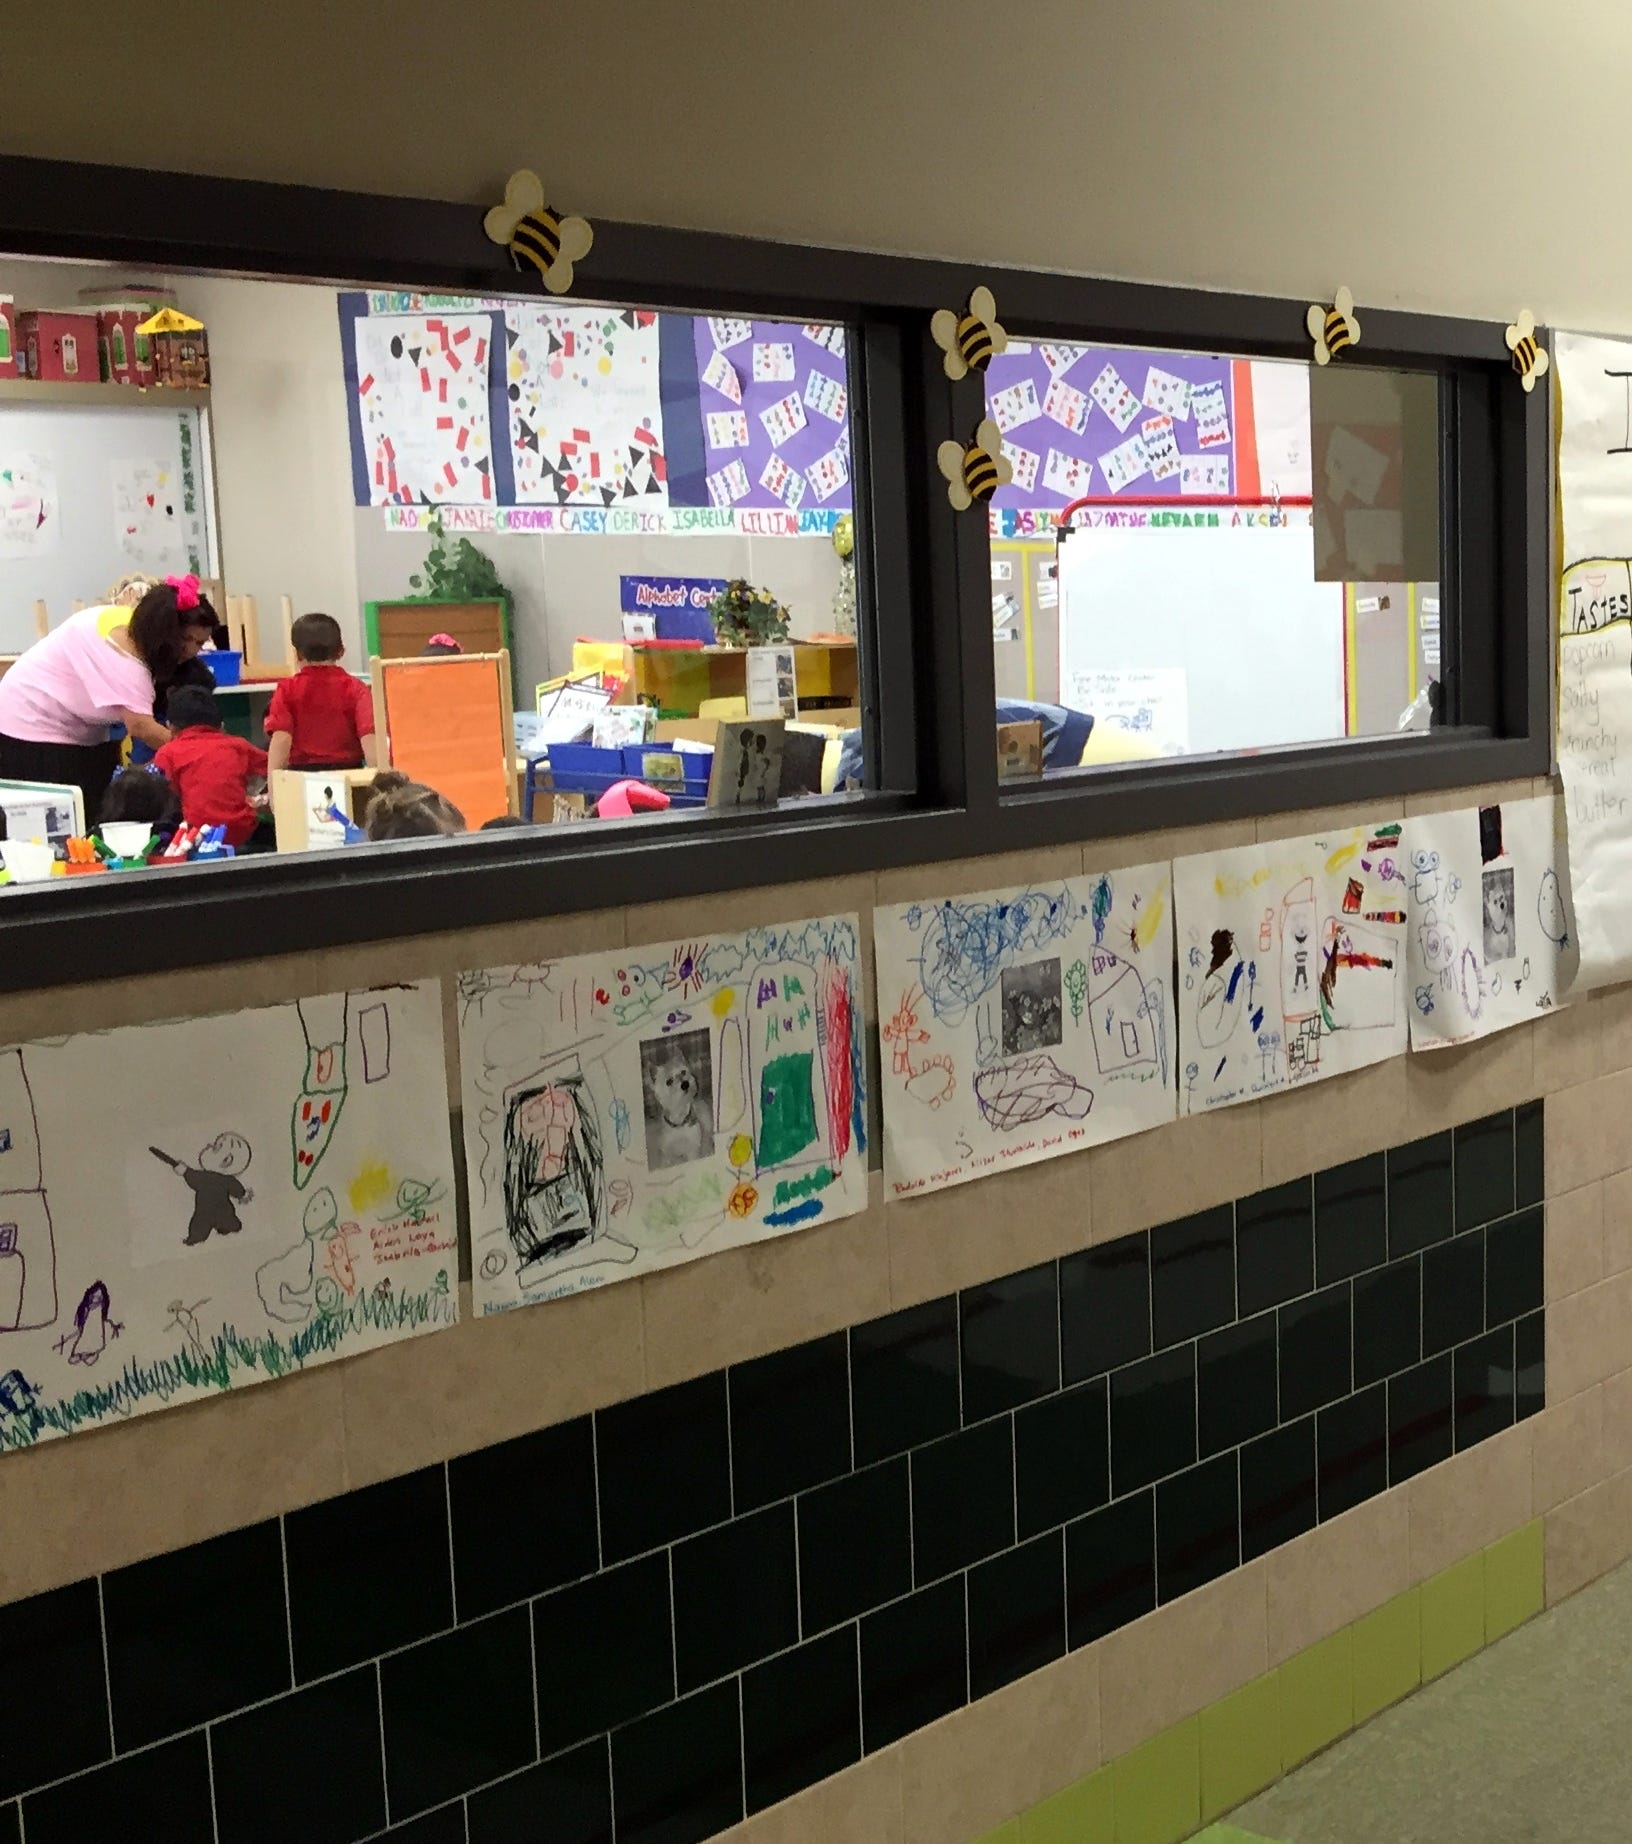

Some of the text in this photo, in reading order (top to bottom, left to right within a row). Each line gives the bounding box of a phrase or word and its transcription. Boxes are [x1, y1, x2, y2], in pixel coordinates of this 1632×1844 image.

[560, 508, 608, 532] CASEY
[613, 510, 667, 532] DERICK
[672, 507, 735, 531] ISABELLA
[636, 583, 722, 608] Alphabet Cent
[1568, 586, 1630, 634] TASTES
